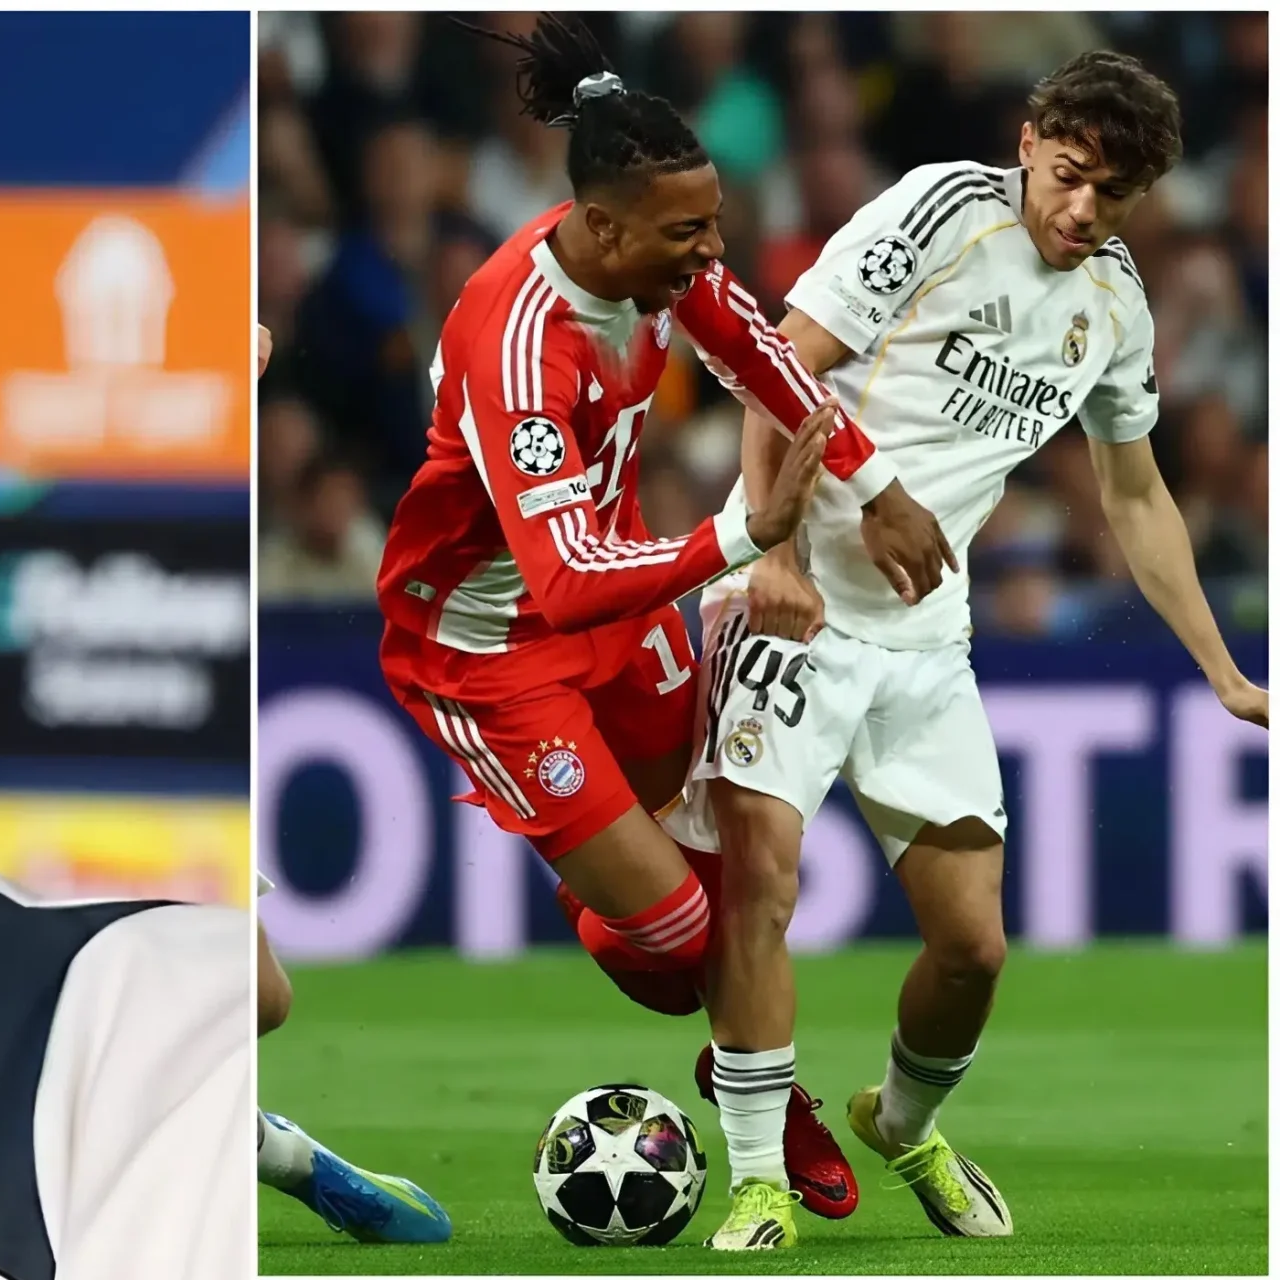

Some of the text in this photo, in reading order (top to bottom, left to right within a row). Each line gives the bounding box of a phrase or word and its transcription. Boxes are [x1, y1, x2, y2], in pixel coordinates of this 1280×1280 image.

[934, 330, 1074, 420] Emirates
[941, 387, 1044, 449] FLY BETTER
[737, 639, 817, 728] 45
